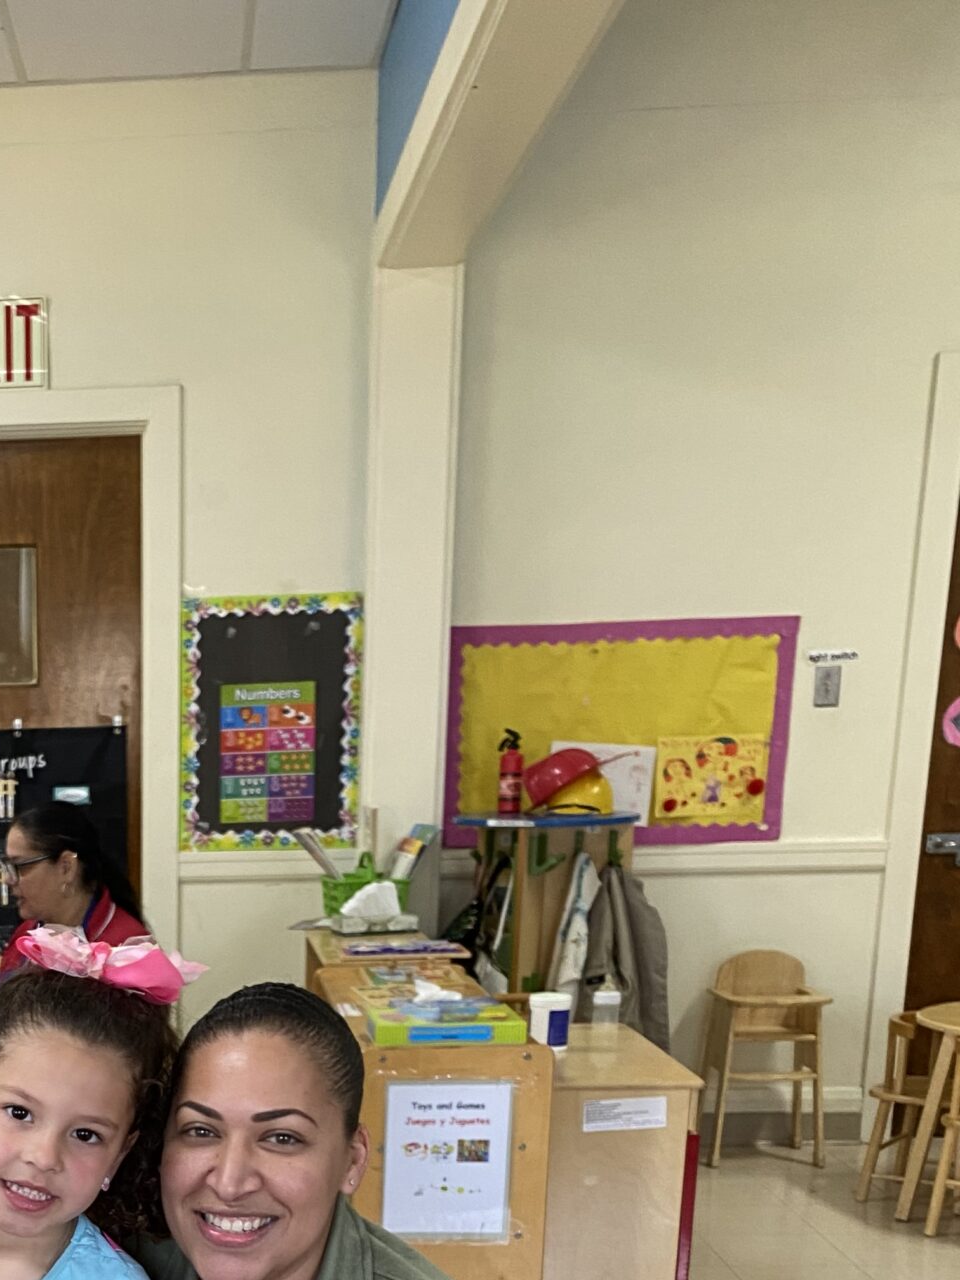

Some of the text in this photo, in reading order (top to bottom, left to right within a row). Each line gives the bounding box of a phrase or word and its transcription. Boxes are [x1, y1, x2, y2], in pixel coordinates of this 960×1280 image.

[234, 687, 301, 701] Numbers
[411, 1101, 486, 1112] Toys and Games
[405, 1116, 436, 1127] Juegos
[449, 1116, 491, 1127] Juguetes
